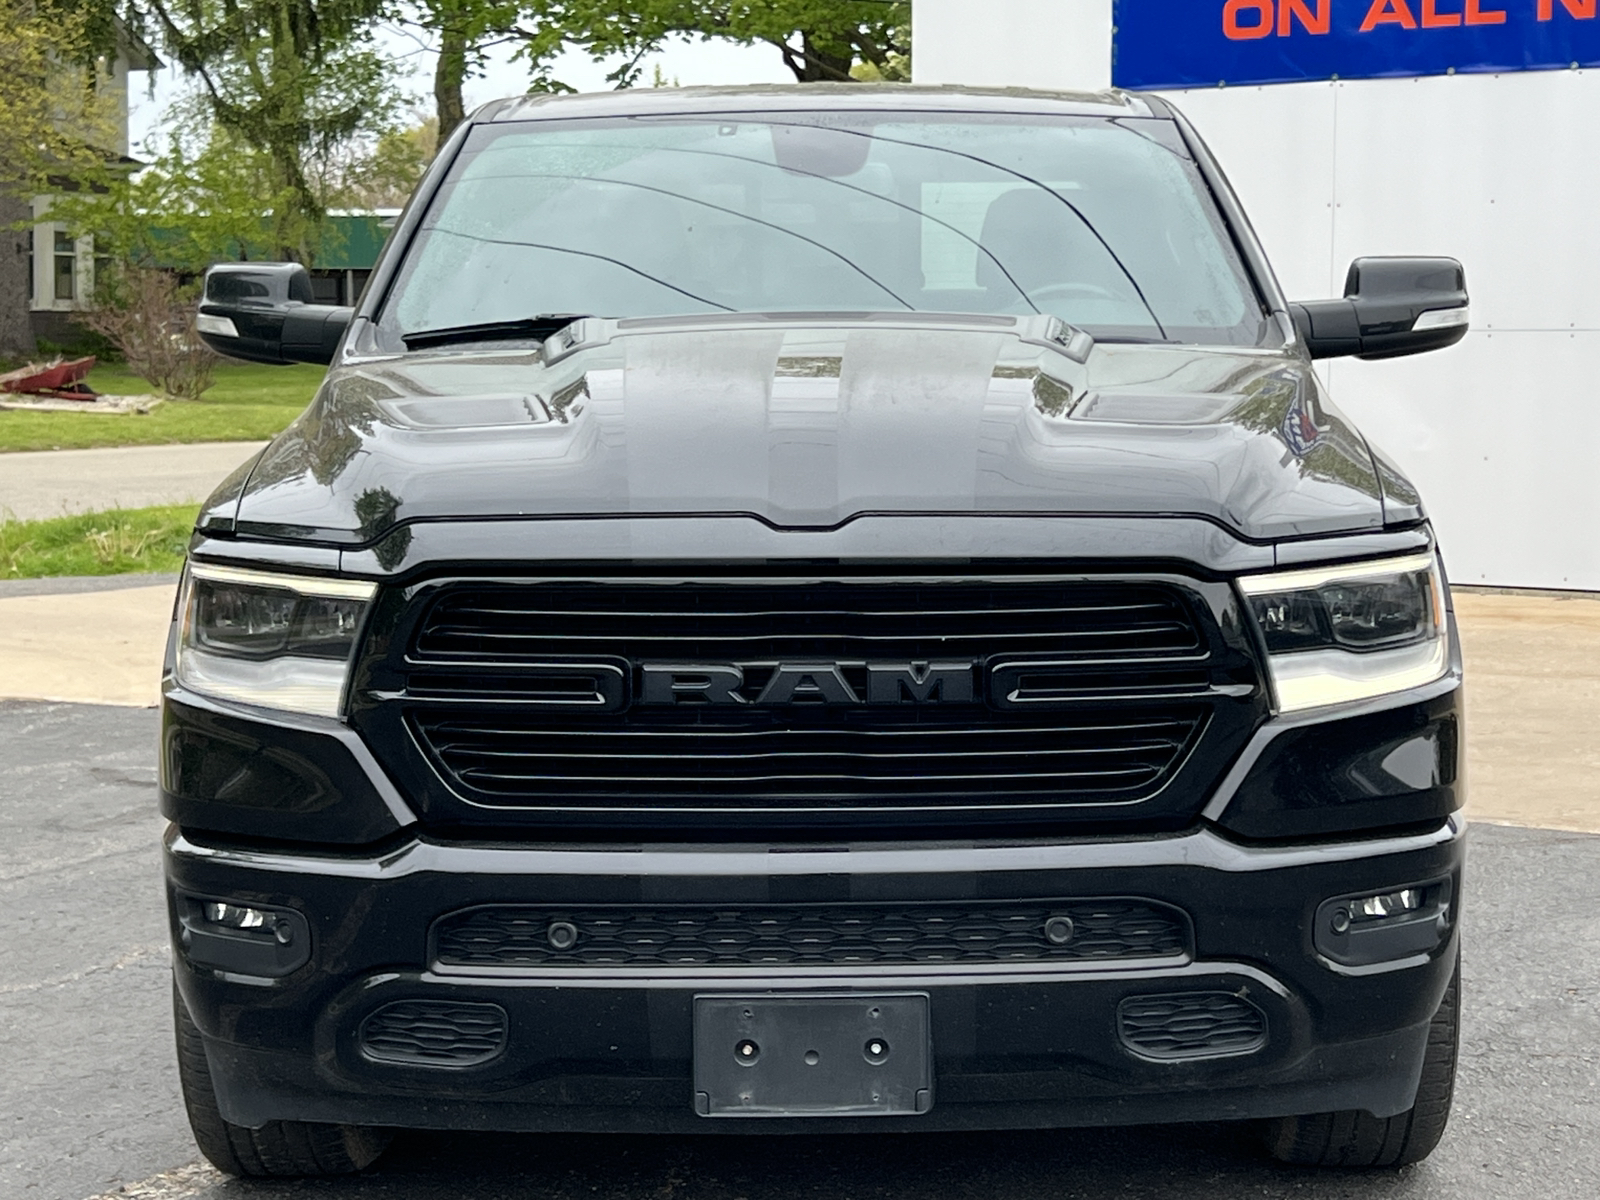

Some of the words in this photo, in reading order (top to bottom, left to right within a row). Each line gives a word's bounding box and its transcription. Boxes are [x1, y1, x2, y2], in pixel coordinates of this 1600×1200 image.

[1223, 0, 1330, 40] ON
[1359, 0, 1506, 32] ALL
[642, 662, 974, 705] RAM
